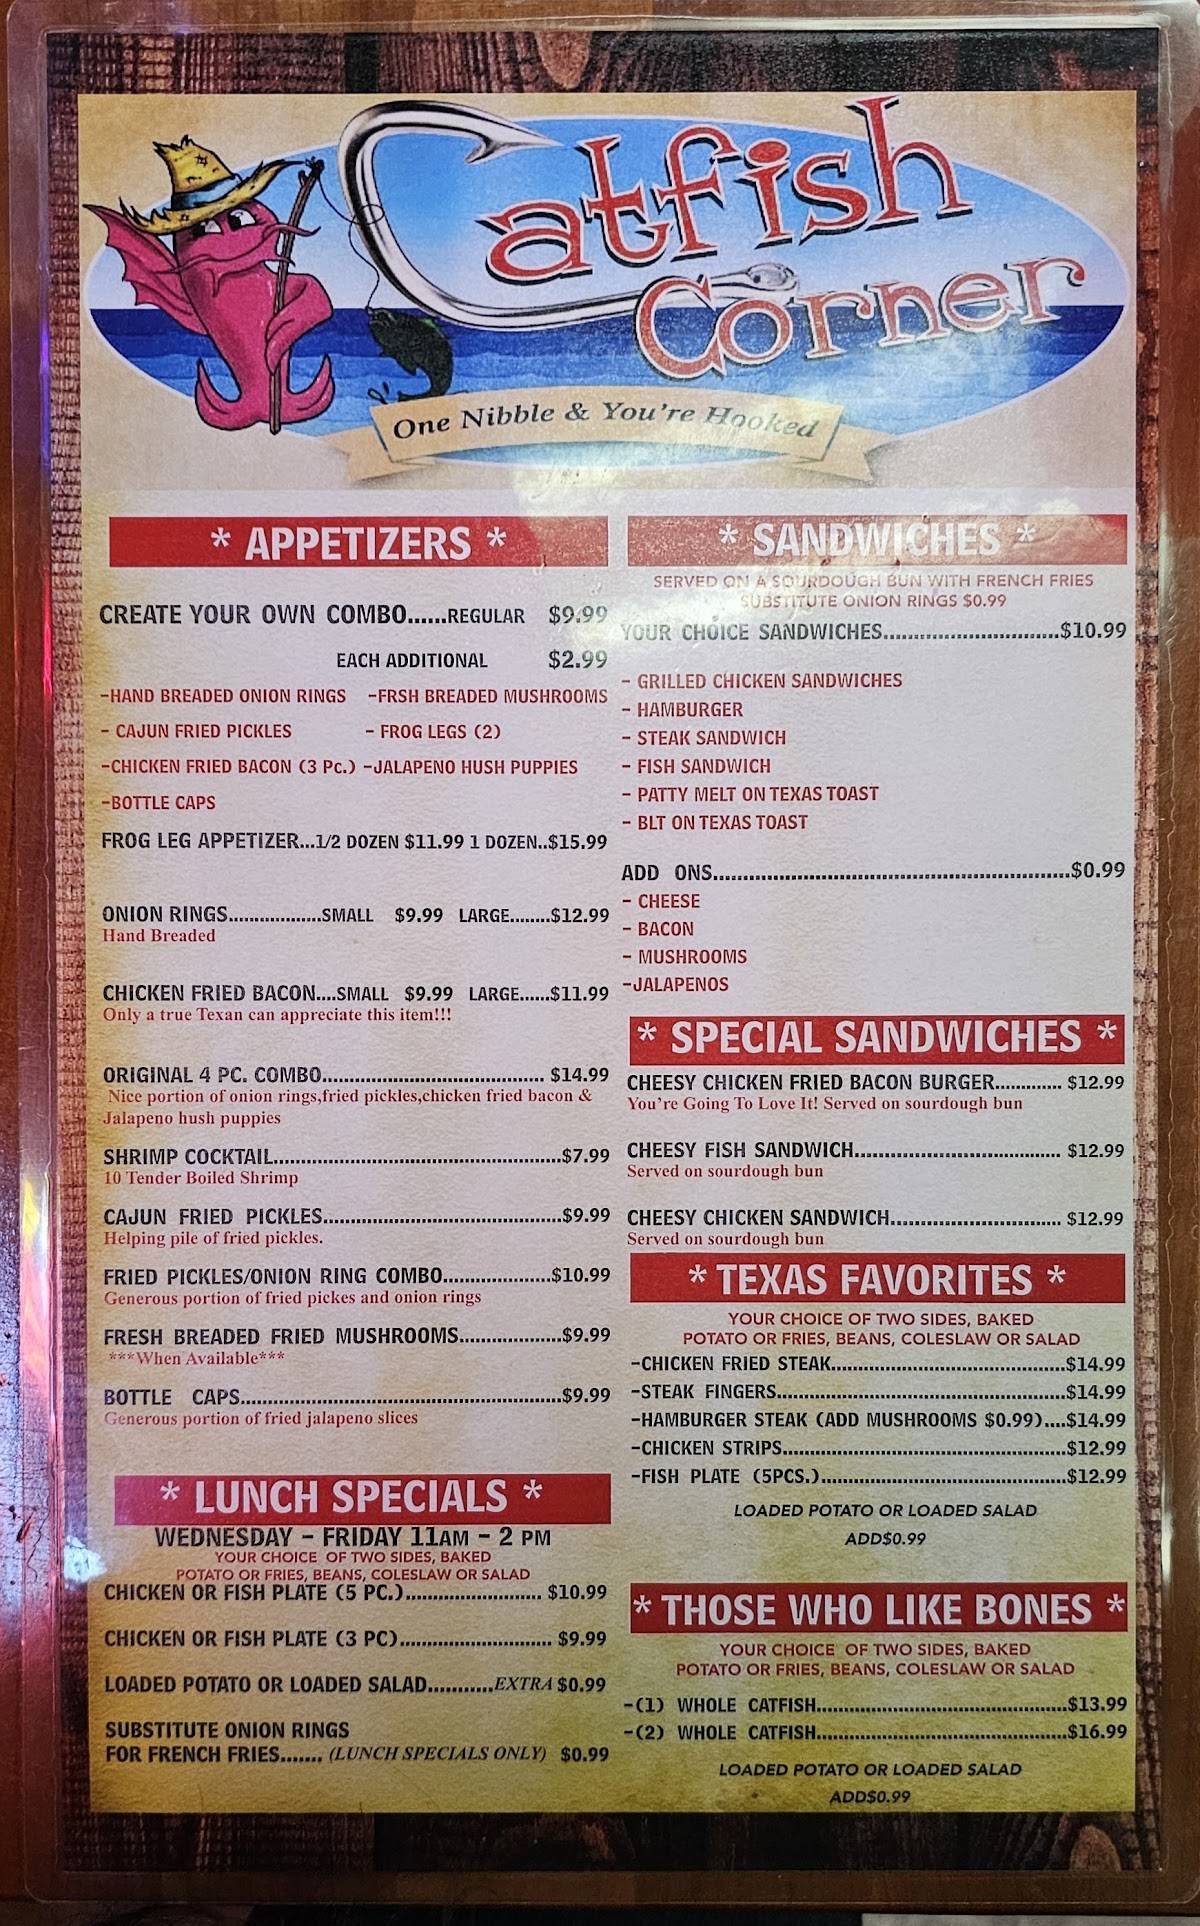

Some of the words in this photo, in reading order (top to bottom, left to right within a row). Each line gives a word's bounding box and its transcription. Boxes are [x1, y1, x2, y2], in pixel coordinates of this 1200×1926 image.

[635, 257, 1087, 381] Corner
[393, 417, 450, 439] One
[460, 405, 554, 430] Nibble
[564, 402, 590, 421] &
[600, 401, 695, 422] You're
[703, 405, 820, 438] Hooked
[245, 527, 471, 561] APPETIZERS
[753, 523, 1001, 557] SANDWICHES
[653, 574, 720, 589] SERVED
[887, 574, 923, 589] BUN
[928, 574, 971, 589] WITH
[977, 574, 1044, 589] FRENCH
[1050, 574, 1094, 589] FRIES
[844, 594, 902, 608] ONION
[907, 594, 957, 608] RINGS
[963, 594, 1008, 608] $0.99
[100, 604, 182, 625] CREATE
[189, 604, 250, 625] YOUR
[262, 604, 315, 625] OWN
[548, 604, 608, 625] $9.99
[621, 623, 671, 642] YOUR
[682, 623, 749, 642] CHOICE
[336, 650, 381, 670] EACH
[386, 650, 488, 670] ADDITIONAL
[548, 650, 608, 670] $2.99
[637, 672, 706, 690] GRILLED
[712, 672, 786, 690] CHICKEN
[791, 672, 903, 690] SANDWICHES
[160, 688, 235, 704] BREADED
[239, 688, 292, 704] ONION
[296, 688, 346, 704] RINGS
[425, 688, 498, 704] BREADED
[504, 688, 608, 704] MUSHROOMS
[637, 701, 744, 718] HAMBURGER
[116, 724, 170, 739] CAJUN
[175, 724, 221, 739] FRIED
[226, 724, 292, 739] PICKLES
[380, 724, 423, 740] FROG
[428, 724, 467, 740] LEGS
[474, 724, 501, 740] (2)
[637, 730, 690, 746] STEAK
[696, 730, 787, 746] SANDWICH
[637, 758, 675, 774] FISH
[680, 758, 771, 774] SANDWICH
[637, 786, 688, 802] PATTY
[694, 786, 736, 802] MELT
[742, 786, 766, 802] ON
[770, 786, 822, 802] TEXAS
[827, 786, 880, 802] TOAST
[638, 894, 700, 909] CHEESE
[103, 929, 145, 944] Hand
[150, 929, 215, 944] Breaded
[638, 922, 694, 937] BACON
[638, 949, 747, 965] MUSHROOMS
[103, 1007, 141, 1024] Only
[146, 1007, 155, 1024] a
[160, 1007, 192, 1024] true
[196, 1007, 243, 1024] Texan
[248, 1007, 276, 1024] can
[280, 1007, 364, 1024] appreciate
[367, 1007, 395, 1024] this
[400, 1007, 452, 1024] item!!!
[670, 1020, 823, 1055] SPECIAL
[834, 1020, 1082, 1055] SANDWICHES
[103, 1067, 193, 1084] ORIGINAL
[199, 1067, 211, 1084] 4
[550, 1067, 609, 1084] $14.99
[627, 1074, 696, 1091] CHEESY
[702, 1074, 783, 1091] CHICKEN
[789, 1074, 844, 1091] FRIED
[849, 1074, 913, 1091] BACON
[1067, 1074, 1125, 1091] $12.99
[103, 1111, 173, 1128] Jalapeno
[178, 1111, 215, 1128] hush
[220, 1111, 281, 1128] puppies
[104, 1171, 121, 1187] 10
[126, 1171, 181, 1187] Tender
[186, 1171, 235, 1187] Boiled
[240, 1171, 299, 1187] Shrimp
[627, 1232, 680, 1248] Served
[685, 1232, 703, 1248] on
[708, 1232, 790, 1248] sourdough
[795, 1232, 824, 1248] bun
[103, 1267, 157, 1286] FRIED
[167, 1267, 311, 1286] PICKLES/ONION
[320, 1267, 367, 1286] RING
[716, 1264, 828, 1296] TEXAS
[840, 1264, 1033, 1296] FAVORITES
[104, 1290, 178, 1307] Generous
[182, 1290, 240, 1307] portion
[245, 1290, 262, 1307] of
[265, 1290, 303, 1307] fried
[307, 1290, 357, 1307] pickes
[361, 1290, 390, 1307] and
[394, 1290, 438, 1307] onion
[442, 1290, 481, 1307] rings
[728, 1312, 775, 1327] YOUR
[780, 1312, 843, 1327] CHOICE
[848, 1312, 873, 1327] OF
[876, 1312, 917, 1327] TWO
[921, 1312, 971, 1327] SIDES,
[977, 1312, 1034, 1327] BAKED
[683, 1332, 748, 1347] POTATO
[752, 1332, 776, 1347] OR
[782, 1332, 831, 1347] FRIES,
[836, 1332, 896, 1347] BEANS,
[902, 1332, 991, 1347] COLESLAW
[996, 1332, 1021, 1347] OR
[1026, 1332, 1081, 1347] SALAD
[194, 1479, 319, 1514] LUNCH
[332, 1479, 508, 1514] SPECIALS
[155, 1527, 293, 1548] WEDNESDAY
[322, 1527, 402, 1548] FRIDAY
[499, 1527, 513, 1548] 2
[521, 1527, 551, 1548] PM
[845, 1532, 926, 1545] ADD$0.99
[661, 1594, 776, 1626] THOSE
[788, 1594, 873, 1626] WHO
[885, 1594, 962, 1626] LIKE
[975, 1594, 1092, 1626] BONES
[104, 1631, 185, 1648] CHICKEN
[192, 1631, 217, 1648] OR
[223, 1631, 266, 1648] FISH
[272, 1631, 328, 1648] PLATE
[335, 1631, 357, 1648] (3
[557, 1631, 607, 1648] $9.99
[104, 1676, 177, 1693] LOADED
[183, 1676, 252, 1693] POTATO
[258, 1676, 283, 1693] OR
[290, 1676, 362, 1693] LOADED
[557, 1676, 606, 1693] $0.99
[677, 1697, 737, 1714] WHOLE
[105, 1722, 219, 1739] SUBSTITUTE
[225, 1722, 285, 1739] ONION
[291, 1722, 350, 1739] RINGS
[105, 1747, 142, 1764] FOR
[148, 1747, 220, 1764] FRENCH
[329, 1747, 398, 1764] (LUNCH
[403, 1747, 489, 1764] SPECIALS
[494, 1747, 547, 1764] ONLY)
[560, 1747, 609, 1764] $0.99
[719, 1763, 788, 1777] LOADED
[793, 1763, 859, 1777] POTATO
[864, 1763, 888, 1777] OR
[893, 1763, 962, 1777] LOADED
[967, 1763, 1022, 1777] SALAD
[829, 1790, 911, 1804] ADD$0.99
